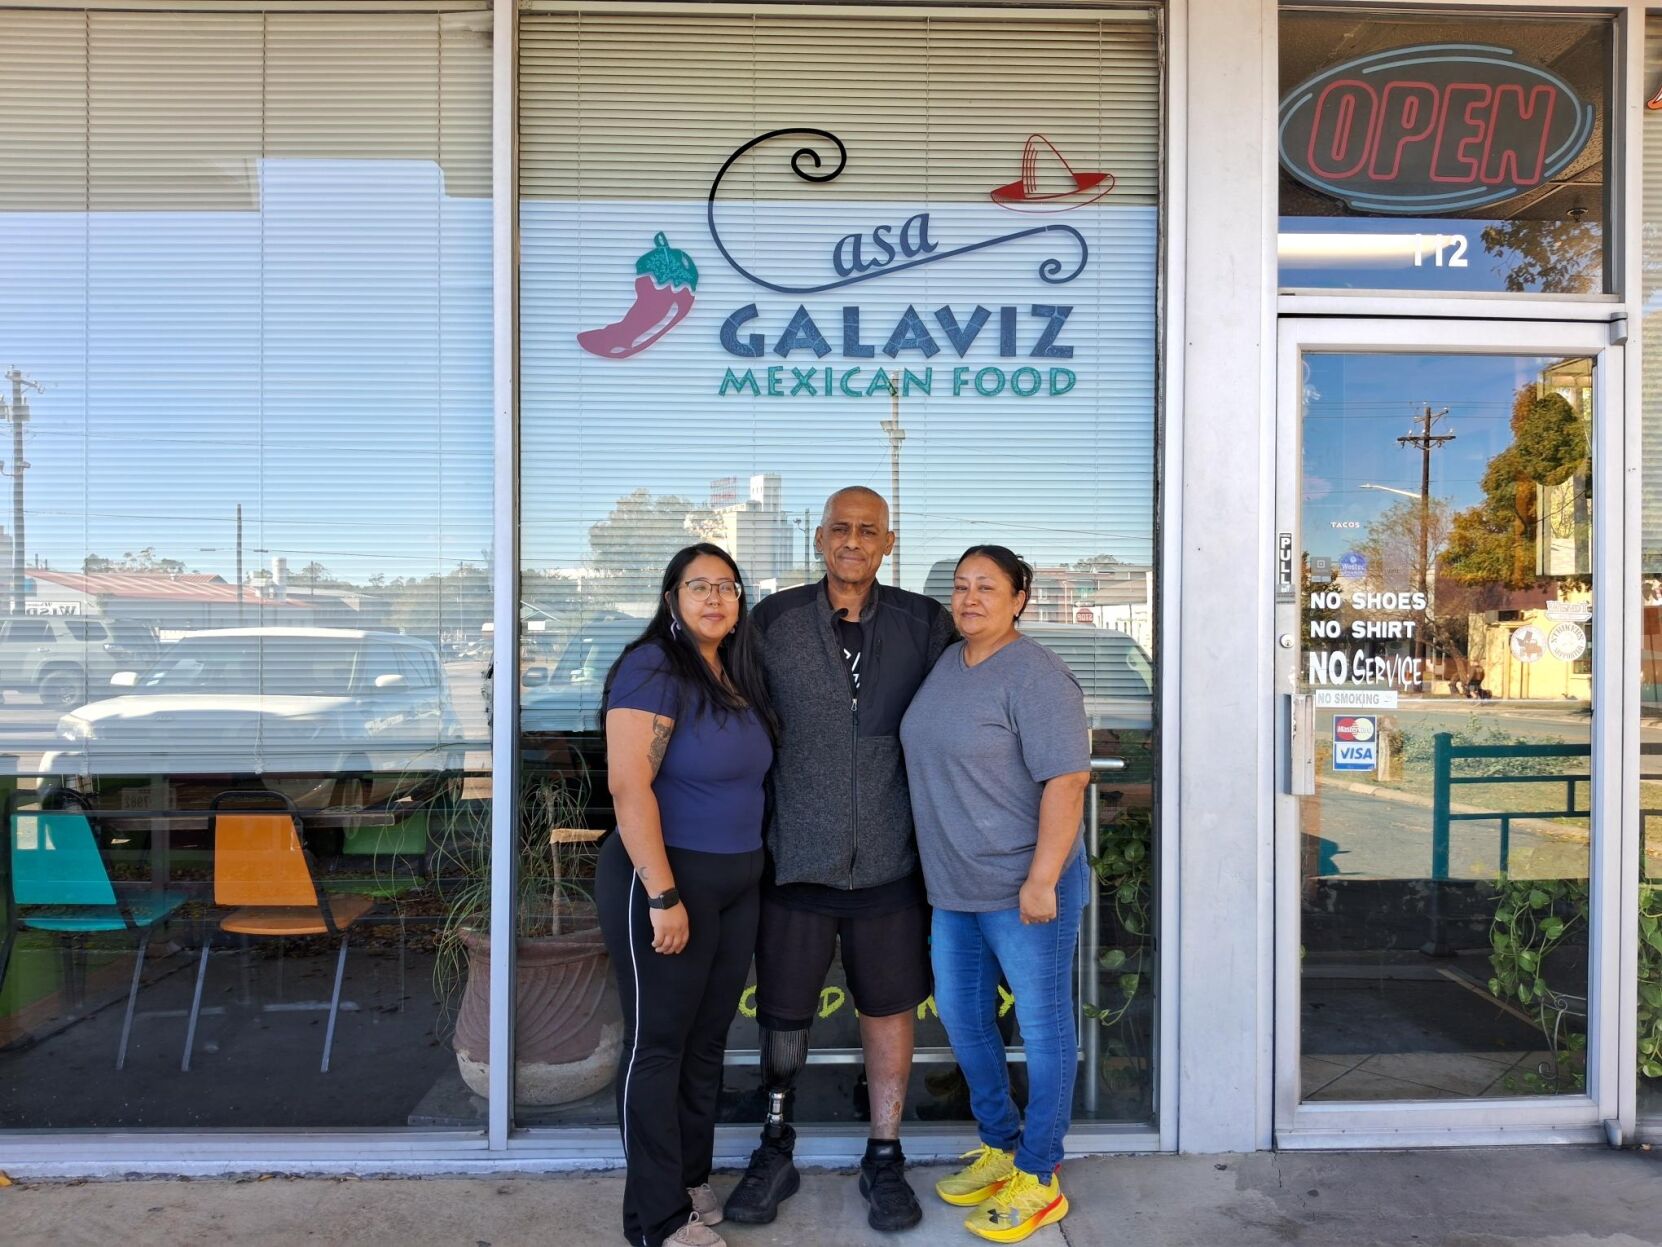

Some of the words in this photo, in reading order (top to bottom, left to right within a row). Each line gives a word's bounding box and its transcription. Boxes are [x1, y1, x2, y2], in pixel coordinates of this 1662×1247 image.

[1307, 79, 1557, 185] OPEN
[708, 128, 1089, 294] Casa
[1414, 233, 1468, 267] 112
[719, 303, 1075, 359] GALAVIZ
[718, 366, 933, 397] MEXICAN
[953, 366, 1077, 397] FOOD
[1280, 537, 1291, 584] PULL
[1310, 592, 1341, 609] NO
[1351, 592, 1427, 610] SHOES
[1310, 620, 1341, 638] NO
[1351, 620, 1416, 638] SHIRT
[1309, 650, 1348, 685] NO
[1318, 692, 1331, 704] NO
[1334, 692, 1379, 704] SMOKING
[1340, 748, 1373, 760] VISA
